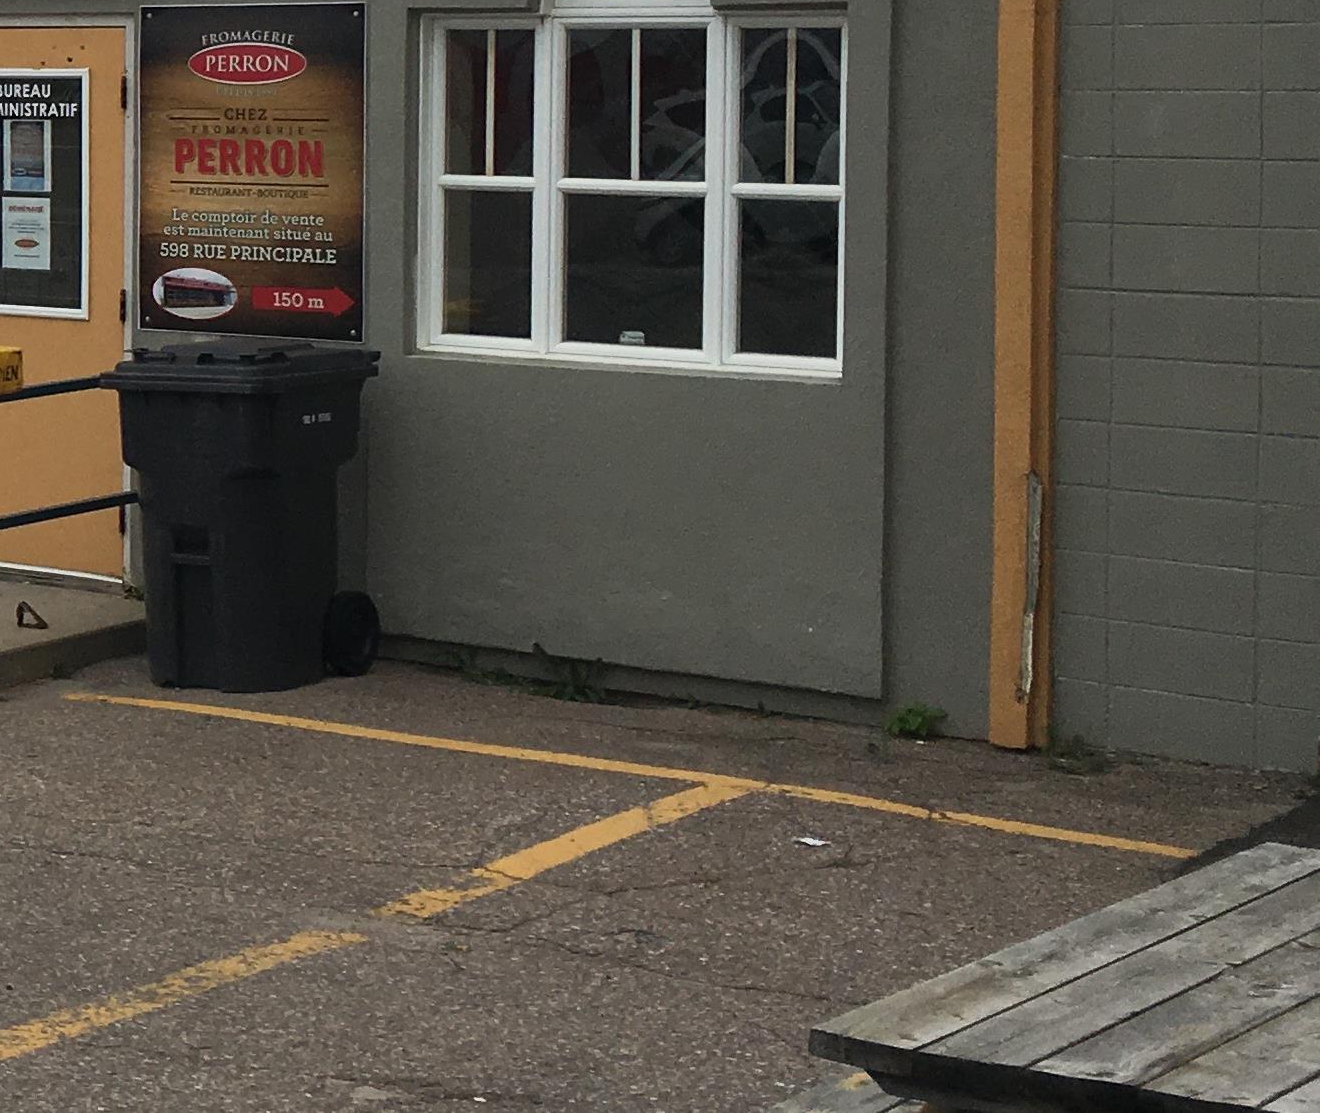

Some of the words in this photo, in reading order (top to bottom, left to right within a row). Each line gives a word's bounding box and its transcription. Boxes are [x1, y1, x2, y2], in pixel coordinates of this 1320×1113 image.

[201, 29, 295, 46] FROMAGERIE
[205, 54, 290, 72] PERRON
[224, 108, 268, 121] CHEZ
[191, 125, 305, 135] FROMAGERIE
[173, 138, 325, 178] PERRON
[189, 187, 309, 199] RESTAURANT-BOUTIQUE
[172, 208, 189, 221] Le
[192, 211, 257, 226] comptoir
[261, 210, 278, 225] de
[282, 214, 324, 226] vente
[163, 225, 184, 236] est
[188, 226, 270, 240] maintenant
[273, 227, 311, 241] situé
[315, 231, 333, 242] au
[160, 242, 189, 258] 598
[193, 244, 227, 260] RUE
[230, 246, 337, 264] PRINCIPALE
[273, 291, 303, 307] 150
[308, 298, 324, 309] m
